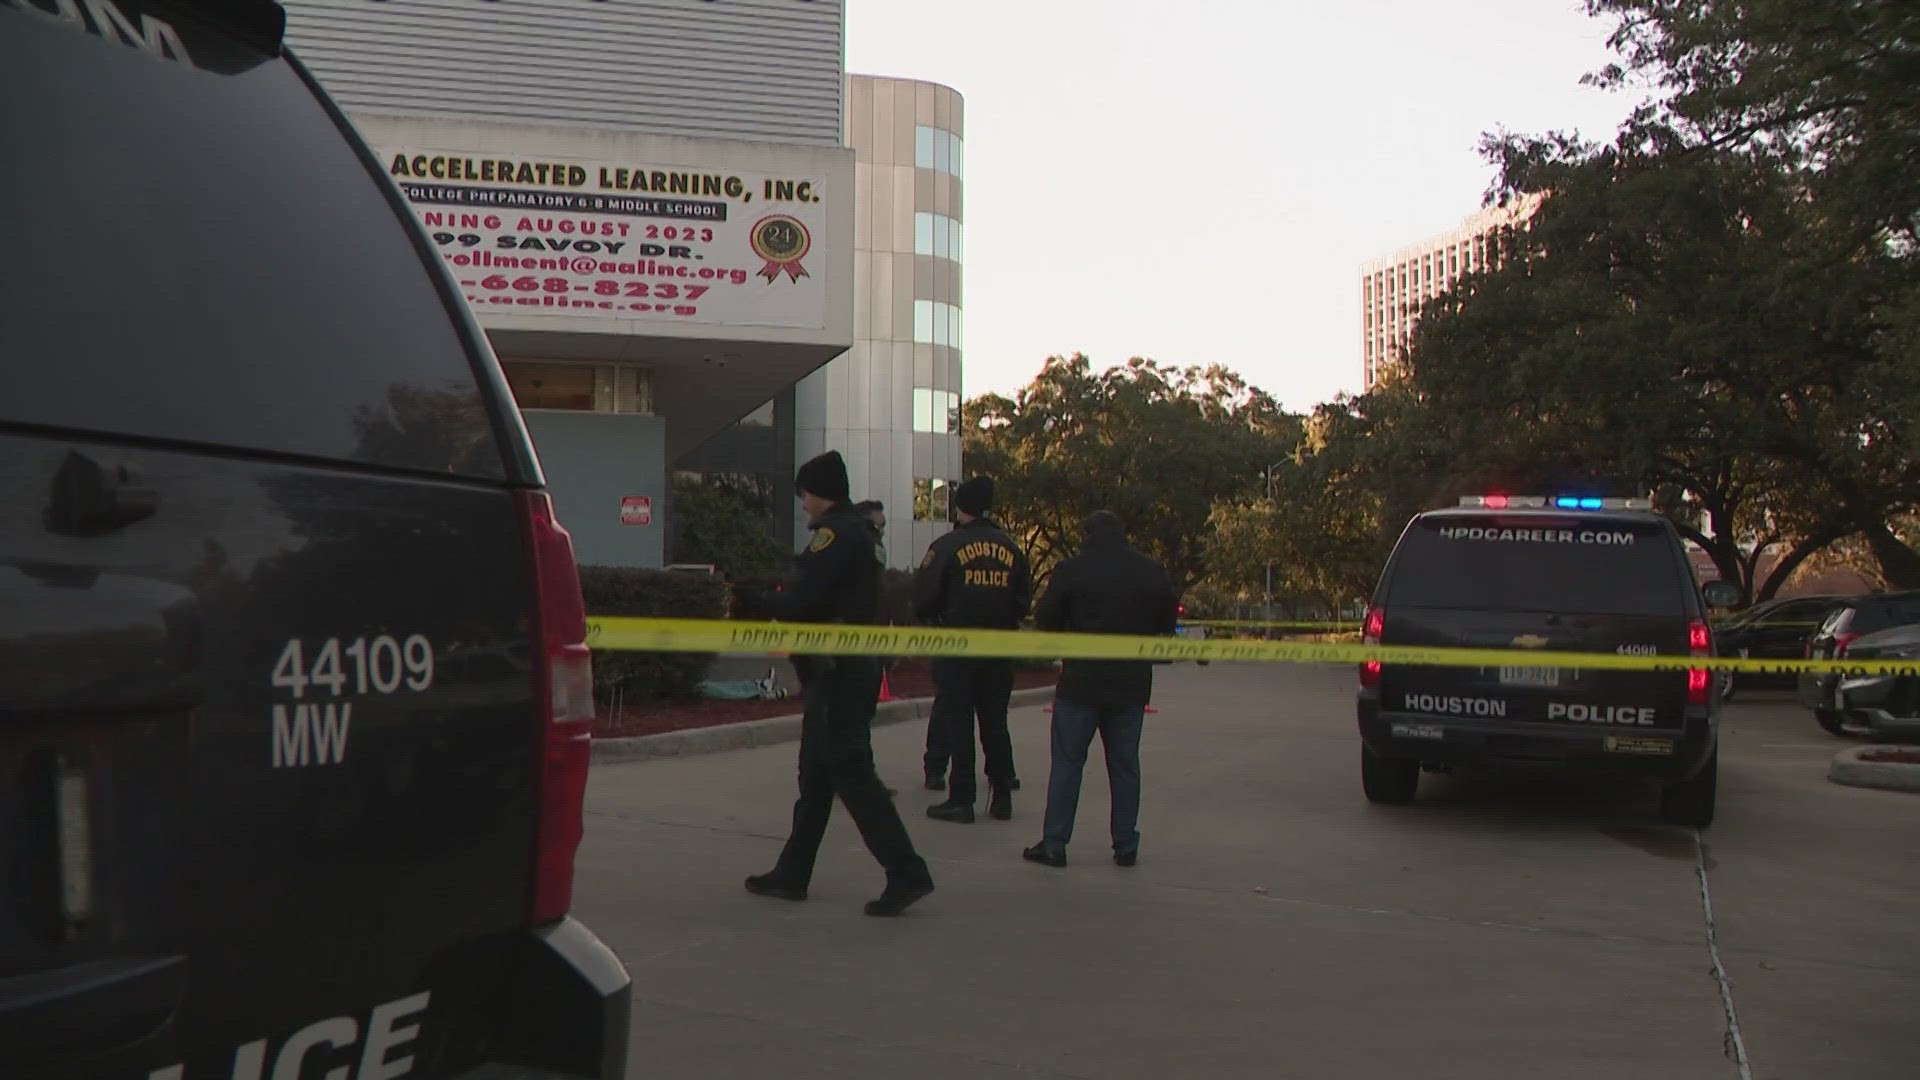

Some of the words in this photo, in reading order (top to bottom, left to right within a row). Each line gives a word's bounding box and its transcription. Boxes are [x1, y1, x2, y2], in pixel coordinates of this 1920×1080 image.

[391, 153, 587, 187] ACCELERATED
[599, 167, 752, 203] LEARNING,
[764, 179, 820, 202] INC.
[404, 187, 462, 200] COLLEGE
[469, 191, 573, 207] PREPARATORY
[608, 198, 659, 214] MIDDLE
[665, 202, 719, 216] SCHOOL
[425, 212, 502, 230] NING
[516, 216, 630, 238] AUGUST
[645, 224, 713, 243] 2023
[433, 232, 481, 247] 99
[496, 235, 626, 255] SAVOY
[639, 243, 704, 260] DR.
[444, 250, 747, 285] ollment@aalinc.org
[461, 274, 710, 300] -668-8237
[467, 295, 697, 316] .aalinc.org
[1439, 527, 1635, 546] HPDCAREER.COM
[956, 541, 1015, 568] HOUSTON
[964, 569, 1009, 587] POLICE
[271, 634, 434, 698] 44109
[1404, 693, 1507, 718] HOUSTON
[1547, 702, 1656, 725] POLICE
[271, 702, 351, 768] MW
